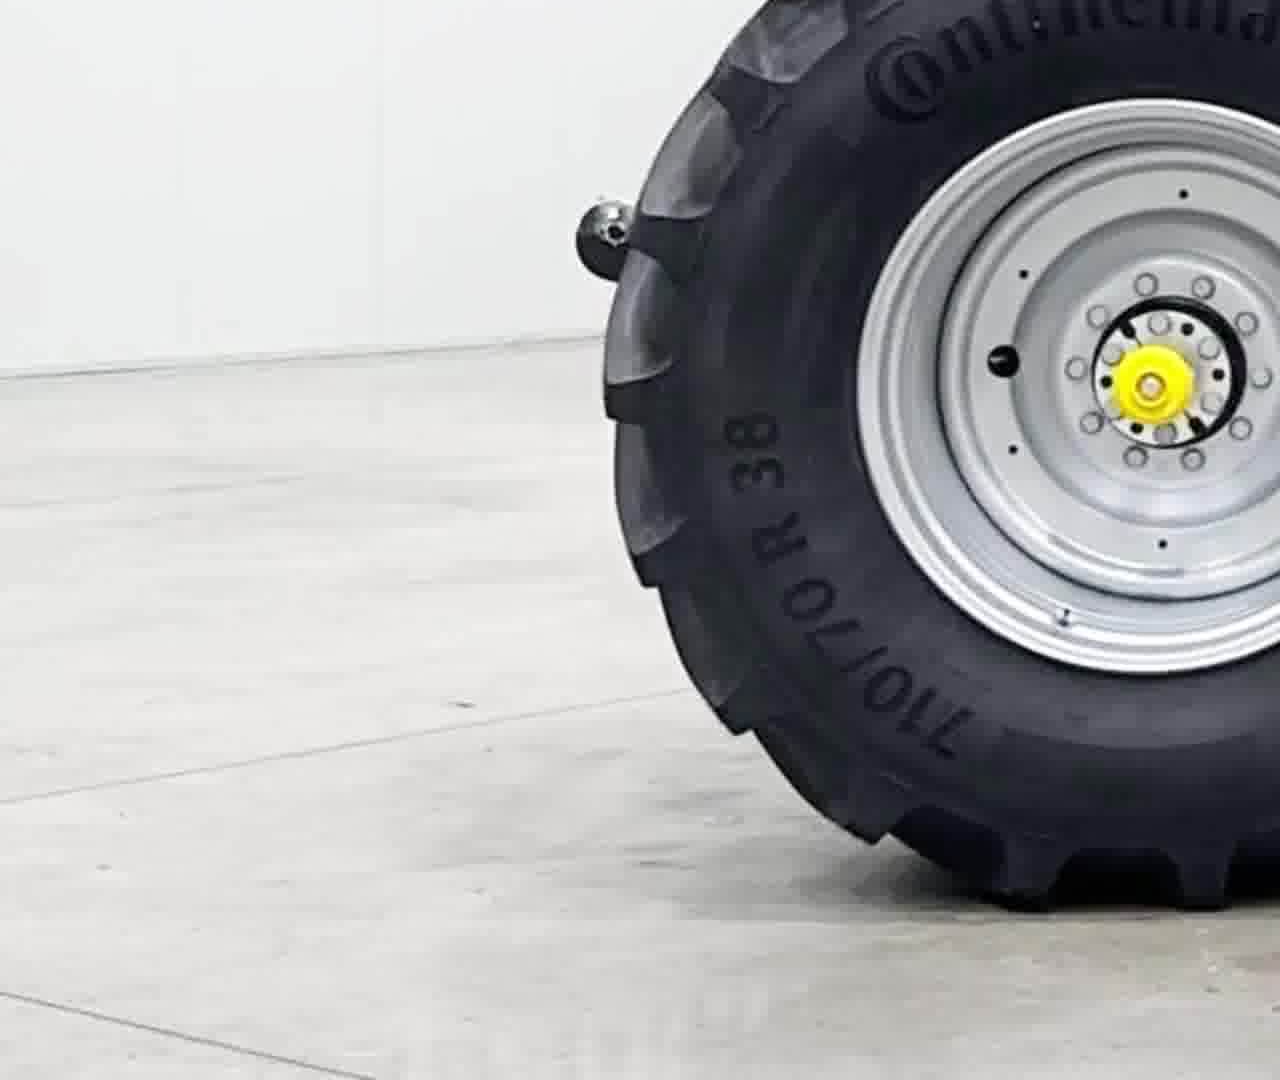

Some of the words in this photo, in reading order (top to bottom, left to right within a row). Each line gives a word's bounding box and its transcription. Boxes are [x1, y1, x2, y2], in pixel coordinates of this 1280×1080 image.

[723, 411, 785, 493] 38
[751, 511, 808, 566] R
[781, 577, 977, 760] 710/70
